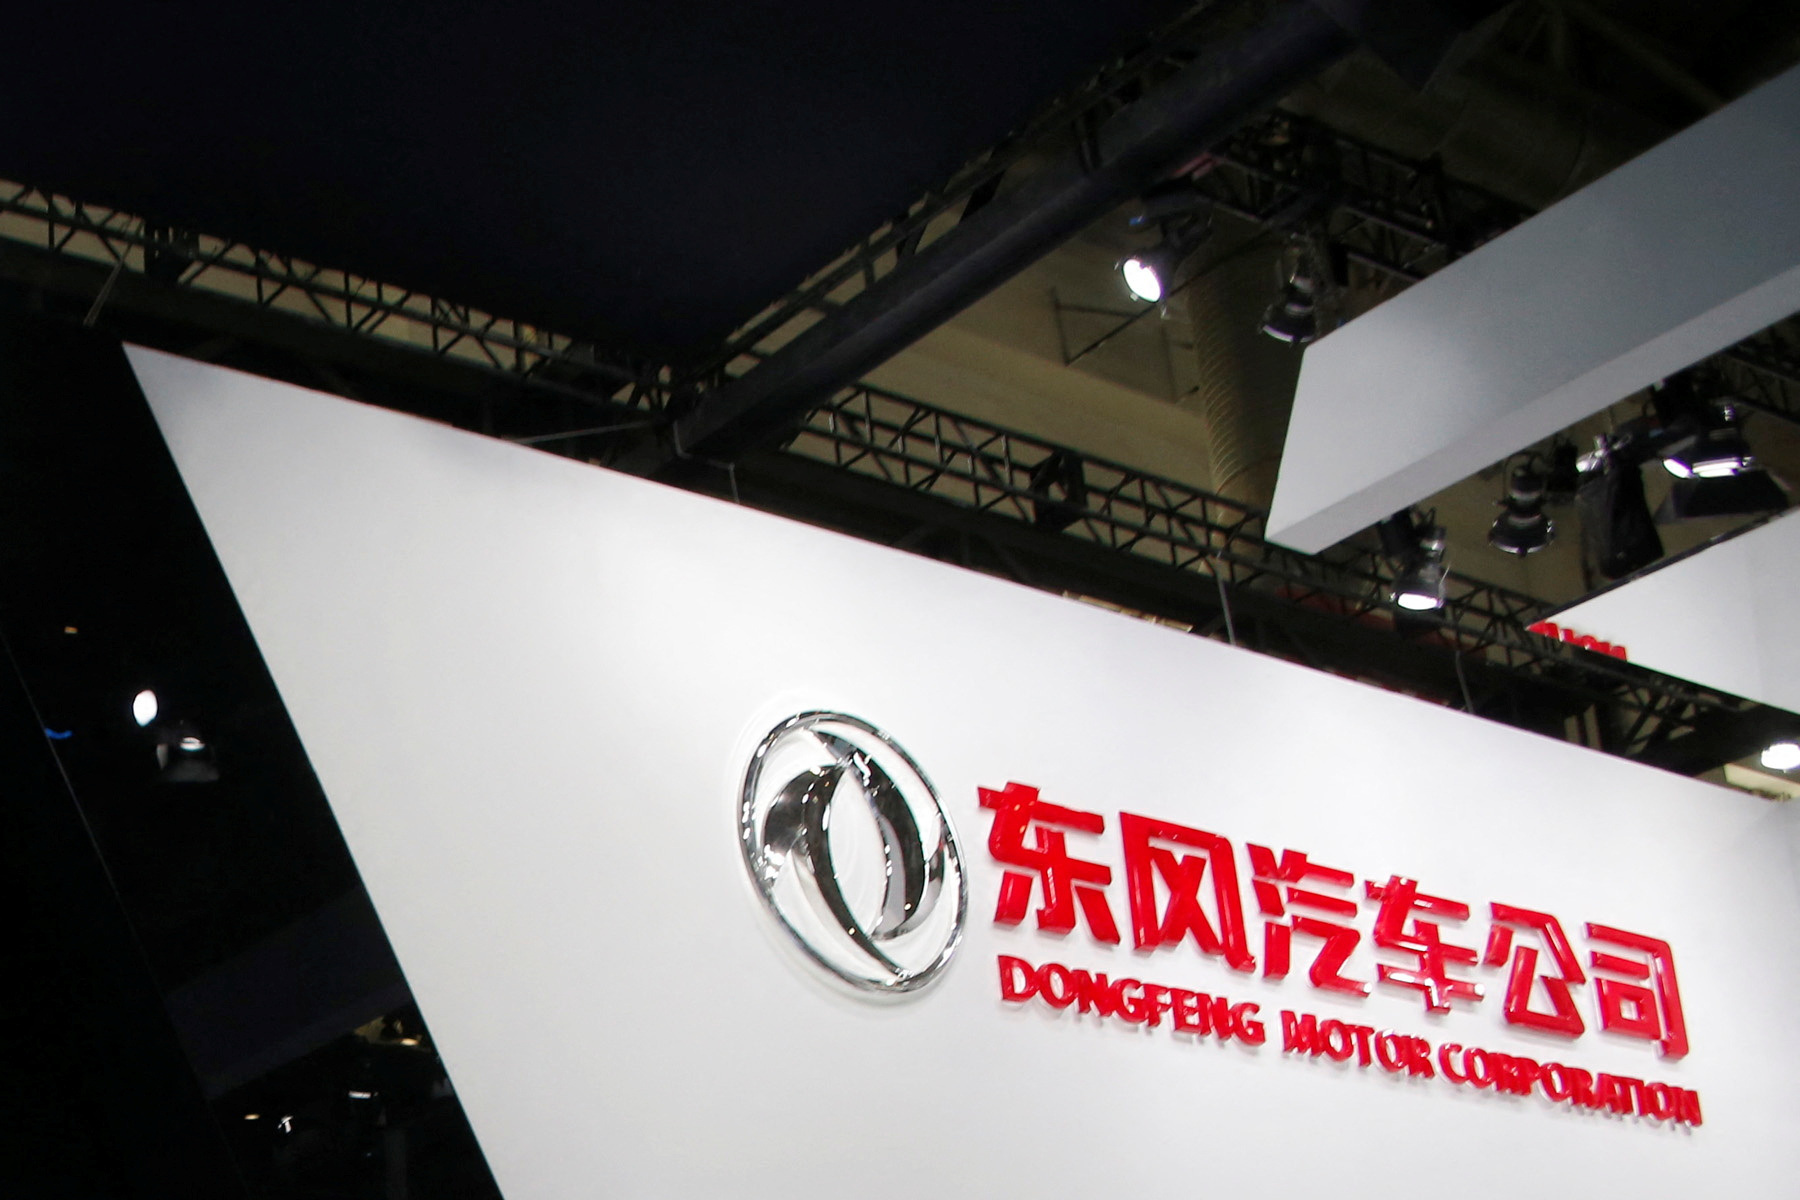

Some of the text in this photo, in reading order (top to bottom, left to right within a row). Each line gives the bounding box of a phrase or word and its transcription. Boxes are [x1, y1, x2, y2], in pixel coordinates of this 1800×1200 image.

[977, 781, 1690, 1060] 东风汽车公司
[997, 954, 1703, 1128] DONGFENG MOTOR CORPORATION
